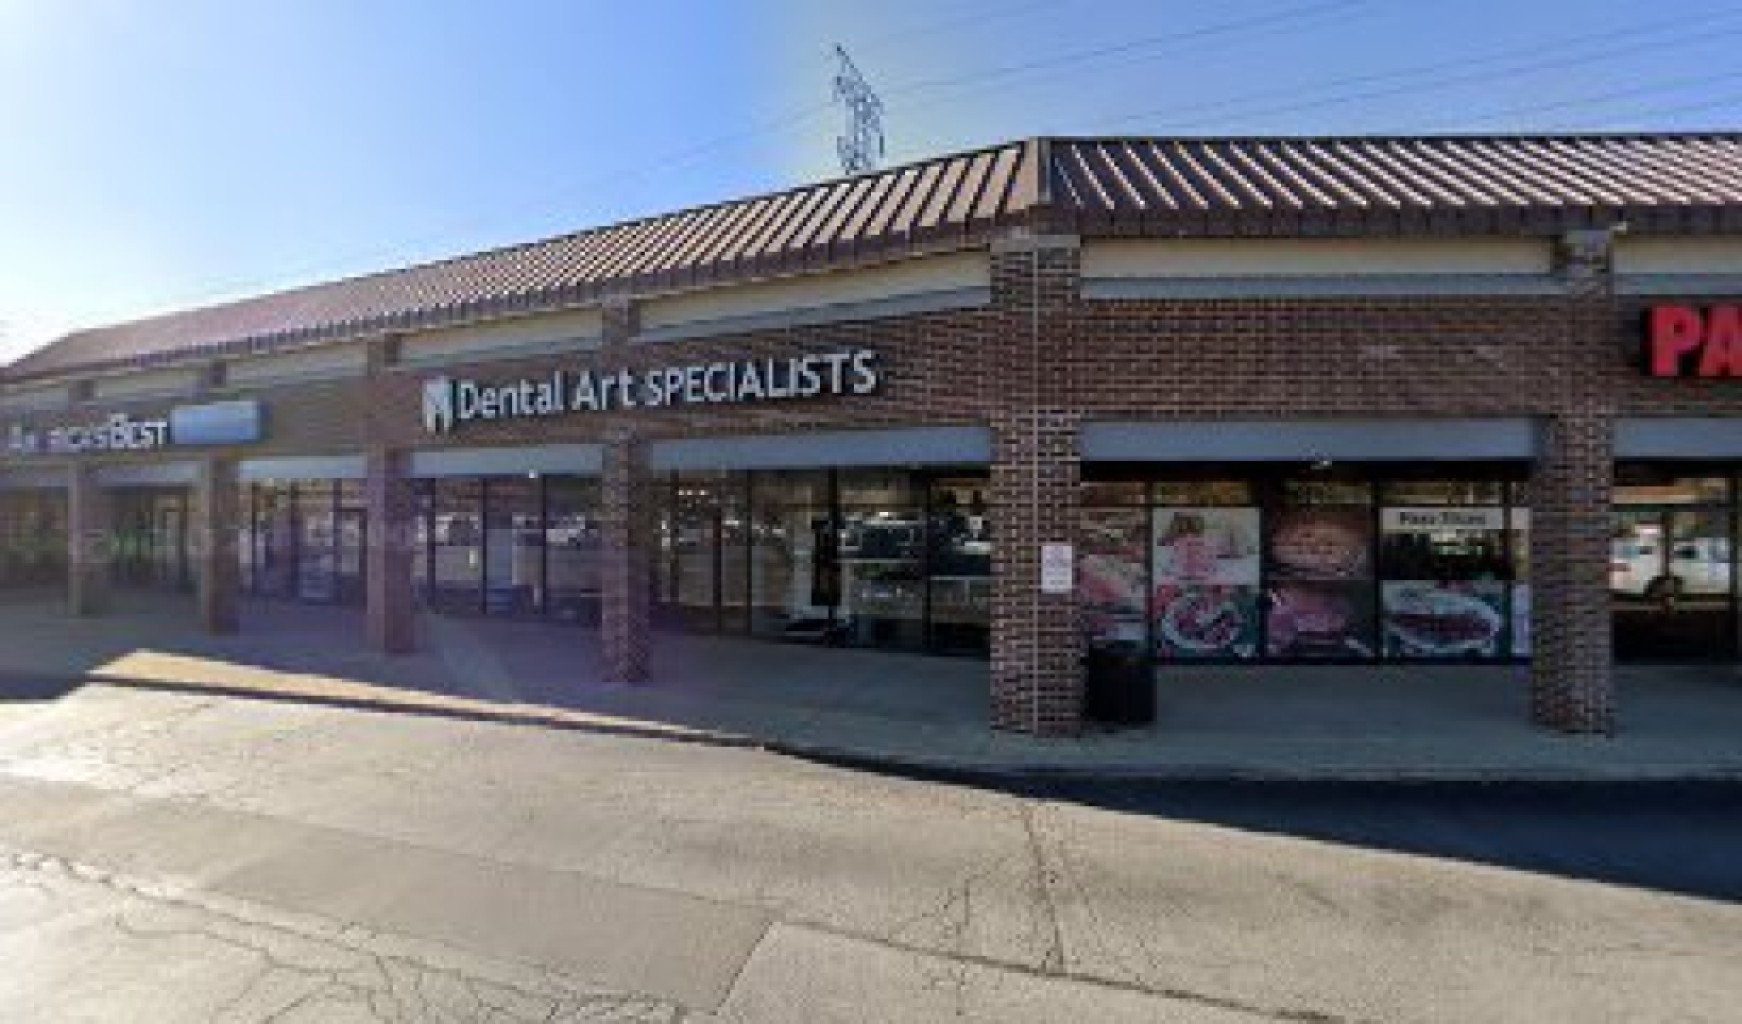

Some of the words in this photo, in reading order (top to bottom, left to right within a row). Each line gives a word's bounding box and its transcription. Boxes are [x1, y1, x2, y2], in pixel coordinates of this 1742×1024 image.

[459, 369, 564, 419] Dental
[572, 367, 637, 411] Art
[644, 350, 877, 405] SPECIALISTS
